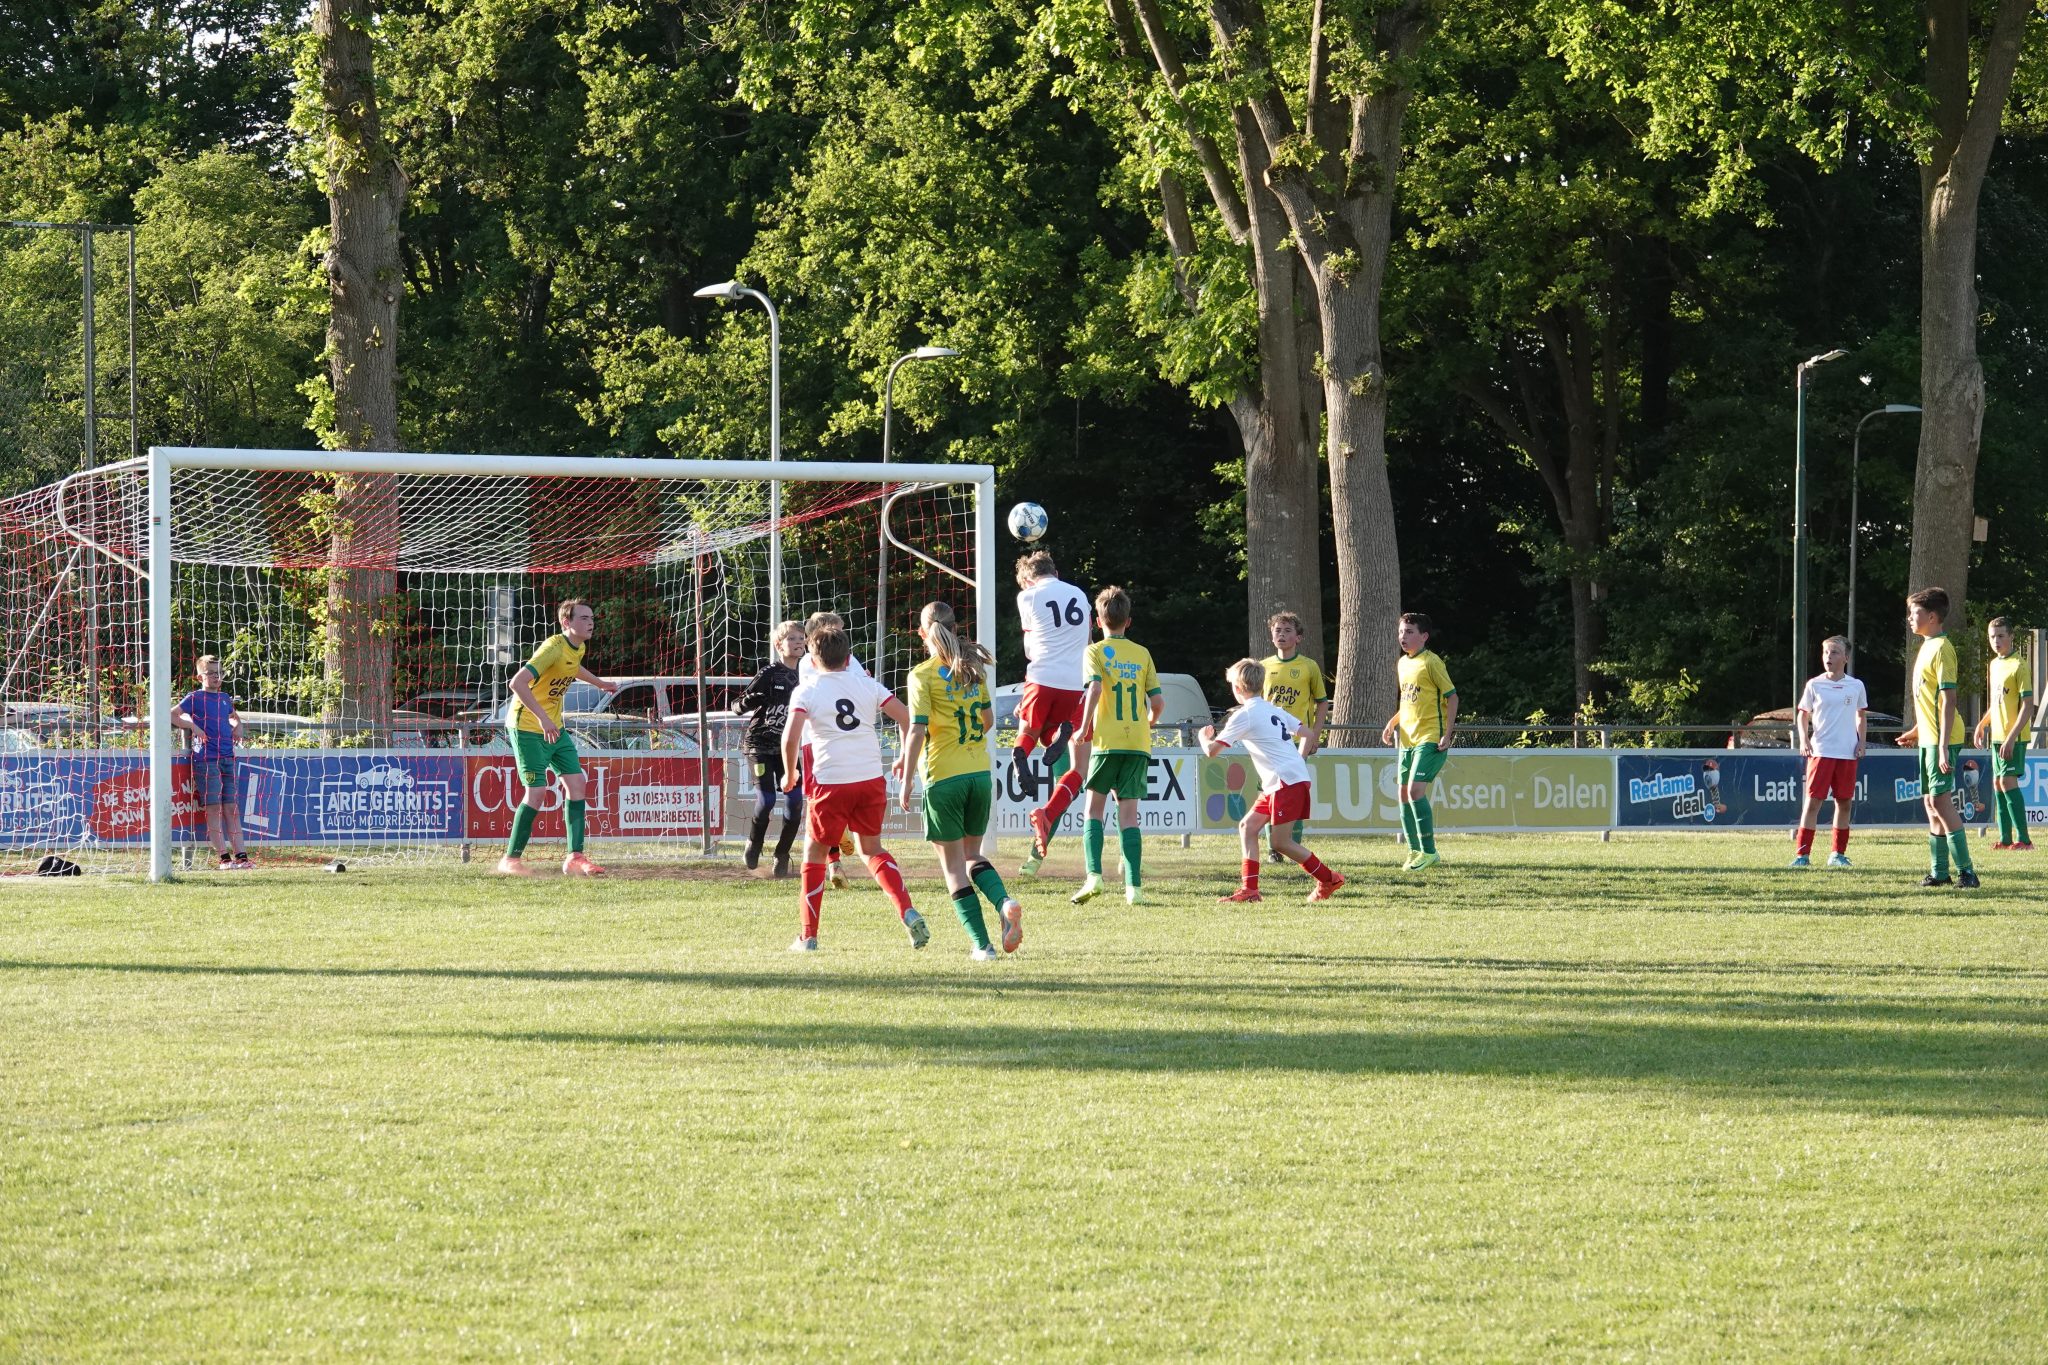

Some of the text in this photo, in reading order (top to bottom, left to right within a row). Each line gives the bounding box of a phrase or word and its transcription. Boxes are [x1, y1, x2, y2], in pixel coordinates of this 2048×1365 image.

[1045, 597, 1084, 628] 16
[1113, 661, 1143, 672] Jarige
[1119, 671, 1137, 679] Job
[835, 698, 861, 731] 8
[1112, 681, 1139, 722] 11
[244, 772, 270, 828] L
[327, 791, 443, 811] ARIE GERRITS
[624, 792, 640, 805] +31
[685, 792, 695, 805] 18
[1430, 777, 1506, 809] Assen
[1534, 775, 1607, 809] Dalen
[1629, 773, 1695, 803] Reclame
[1754, 774, 1797, 802] Laat
[109, 808, 145, 826] JOUW
[1673, 789, 1706, 819] deal
